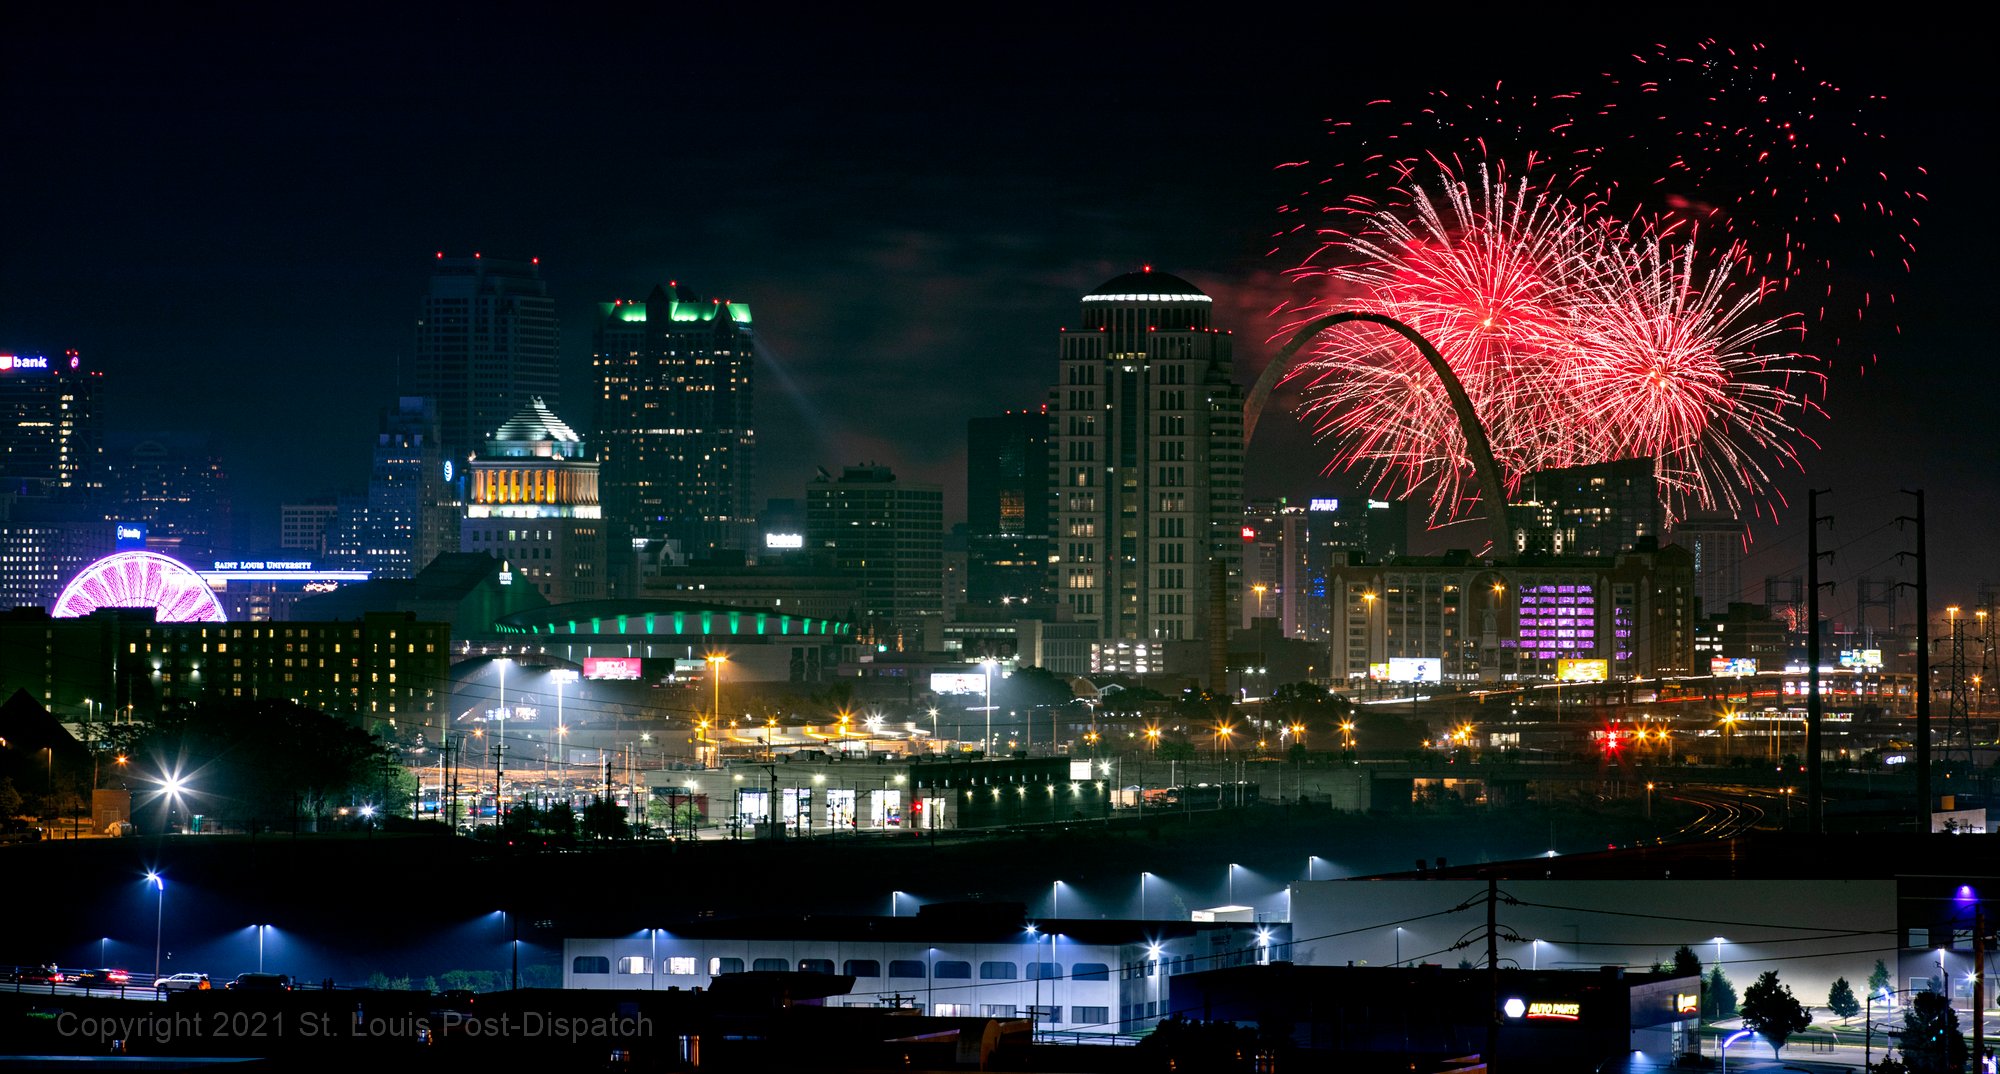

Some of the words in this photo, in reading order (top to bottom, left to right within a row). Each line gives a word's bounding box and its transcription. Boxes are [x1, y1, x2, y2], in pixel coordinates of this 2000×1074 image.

[13, 356, 47, 368] bank
[1309, 499, 1338, 511] KPMG
[1529, 1003, 1553, 1013] AUTO
[1553, 1003, 1579, 1014] PARTS
